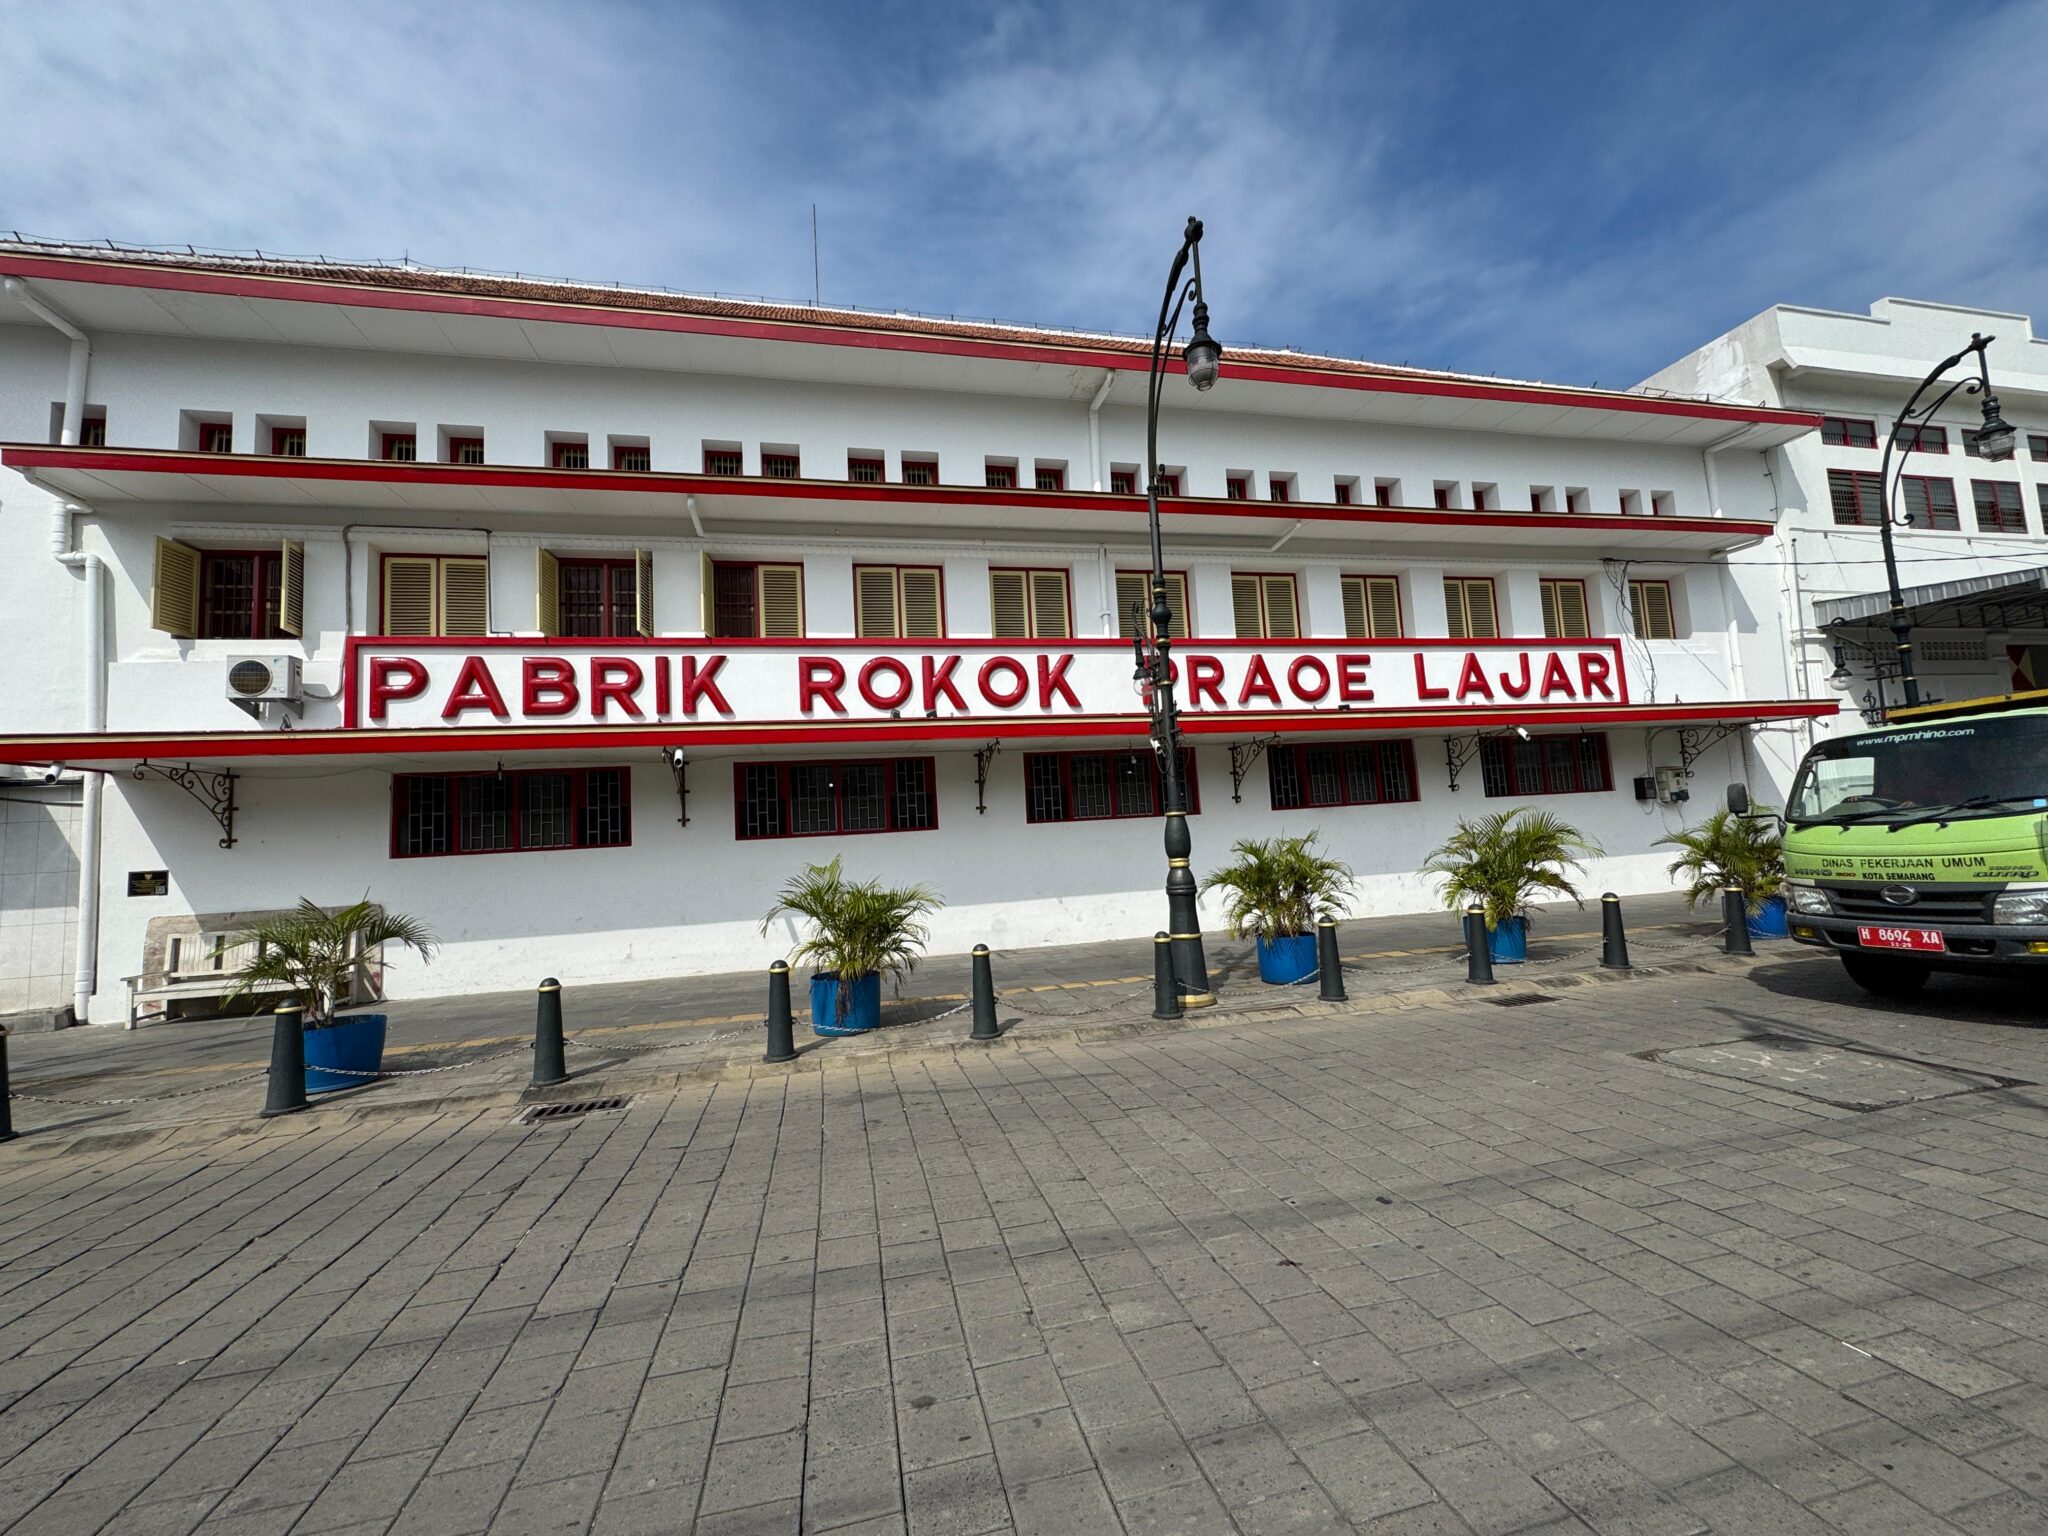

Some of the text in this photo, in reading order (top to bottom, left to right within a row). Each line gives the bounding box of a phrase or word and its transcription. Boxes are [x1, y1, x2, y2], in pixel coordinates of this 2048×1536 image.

[369, 655, 733, 718] PABRIK
[798, 654, 1082, 712] ROKOK
[1414, 652, 1614, 699] LAJAR
[1856, 728, 1975, 746] www.mpmhino.com
[1821, 856, 1986, 868] DINAS PEKERJAAN UMUM
[1862, 872, 1936, 881] KOTA SEMARANG
[1861, 928, 1940, 944] H 8694 XA
